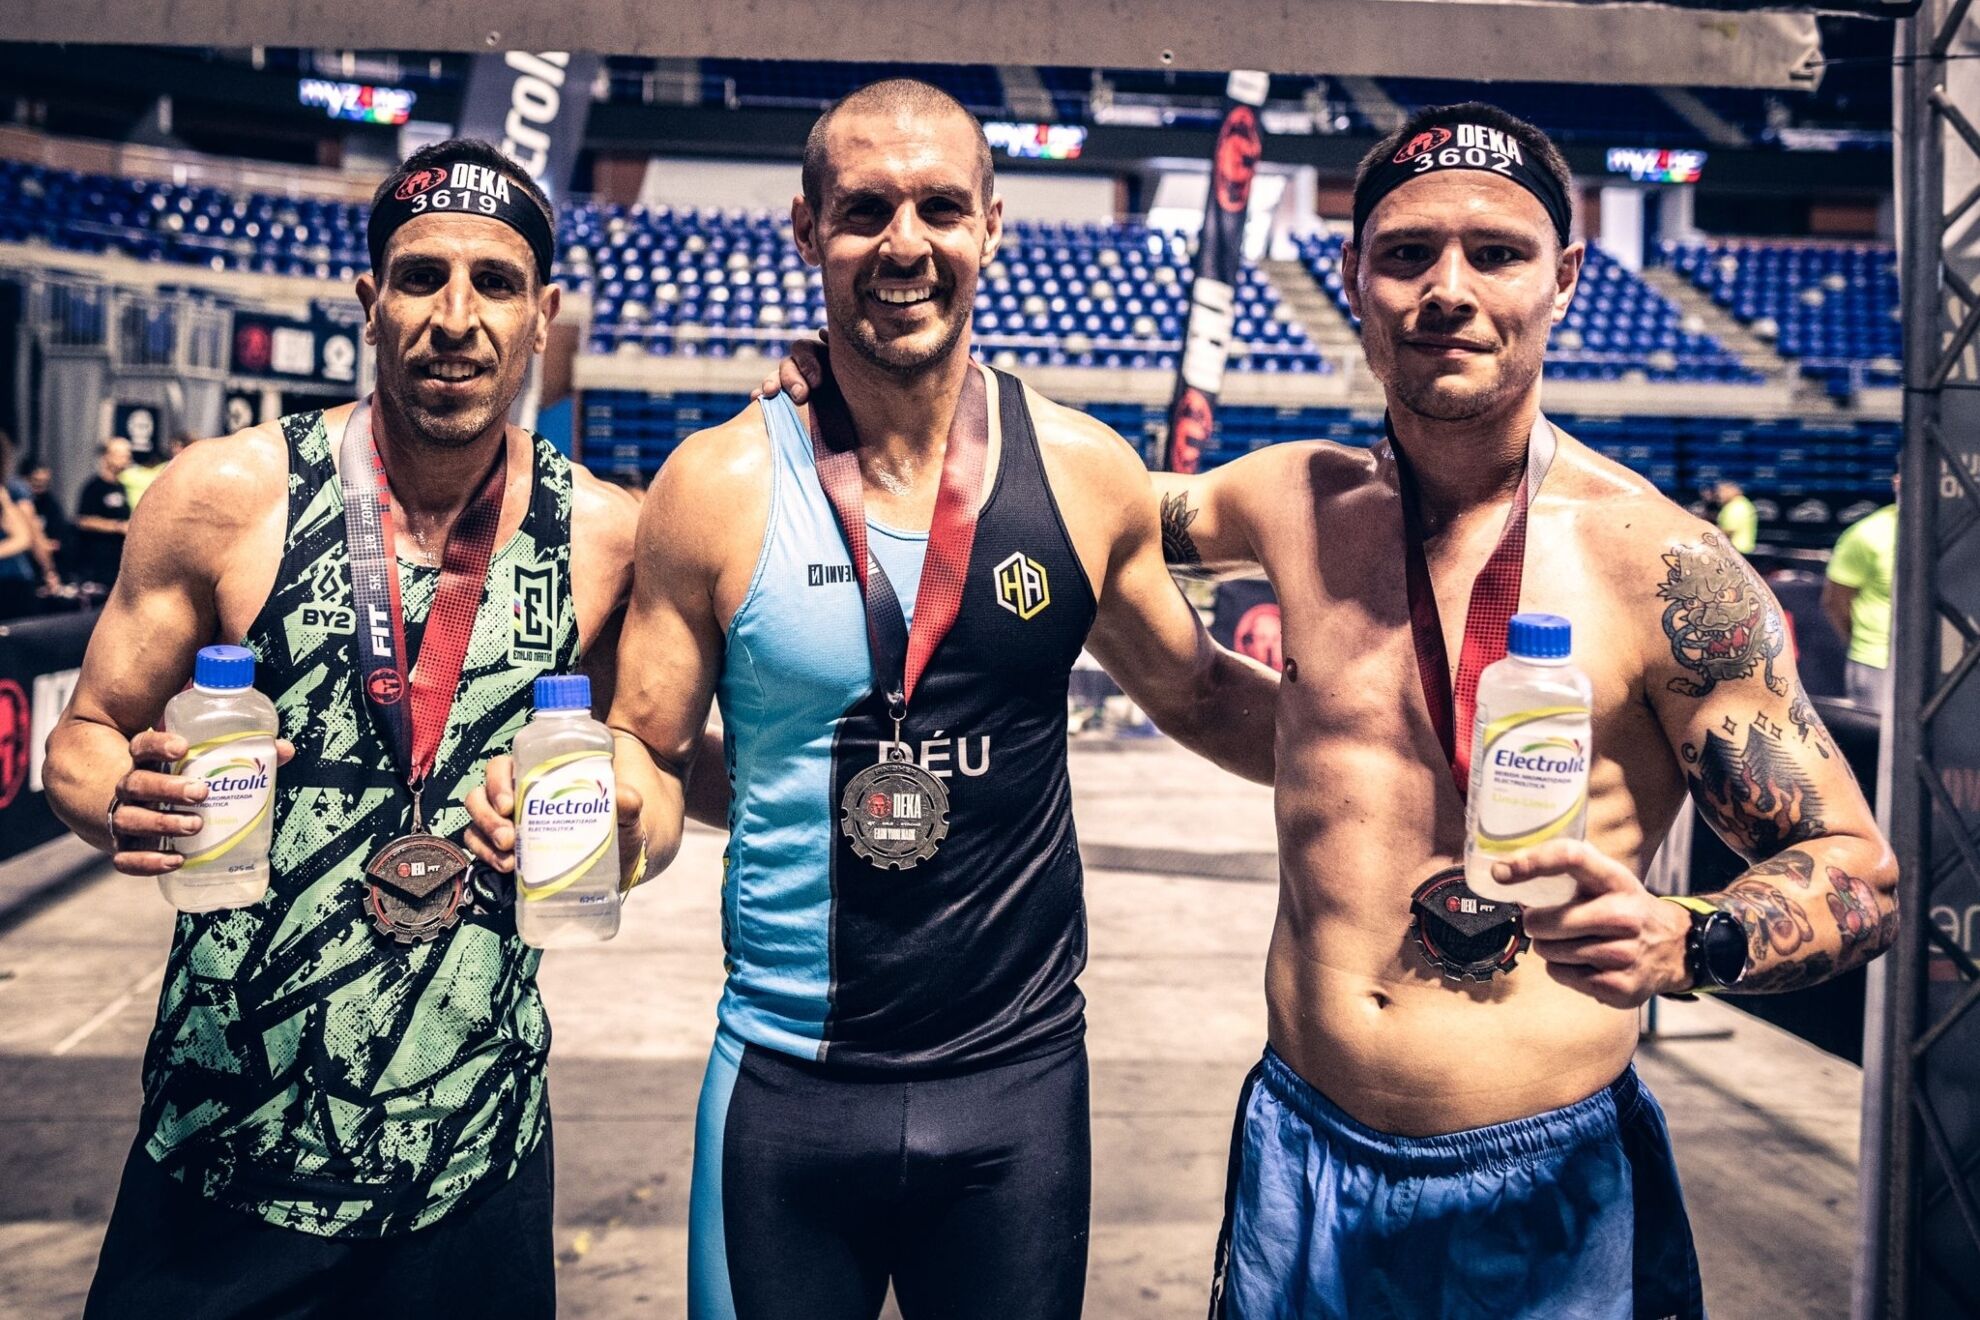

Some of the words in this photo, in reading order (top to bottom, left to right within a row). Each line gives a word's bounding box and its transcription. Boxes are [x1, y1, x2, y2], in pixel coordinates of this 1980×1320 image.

[1457, 124, 1523, 165] DEKA
[1414, 147, 1512, 176] 3602
[450, 163, 510, 205] DEKA
[411, 189, 497, 214] 3619
[370, 573, 382, 590] 5K
[302, 609, 350, 629] BY2
[368, 603, 392, 657] FIT
[1494, 749, 1585, 773] Electrolit
[527, 798, 610, 815] Electrolit
[893, 793, 922, 818] DEKA
